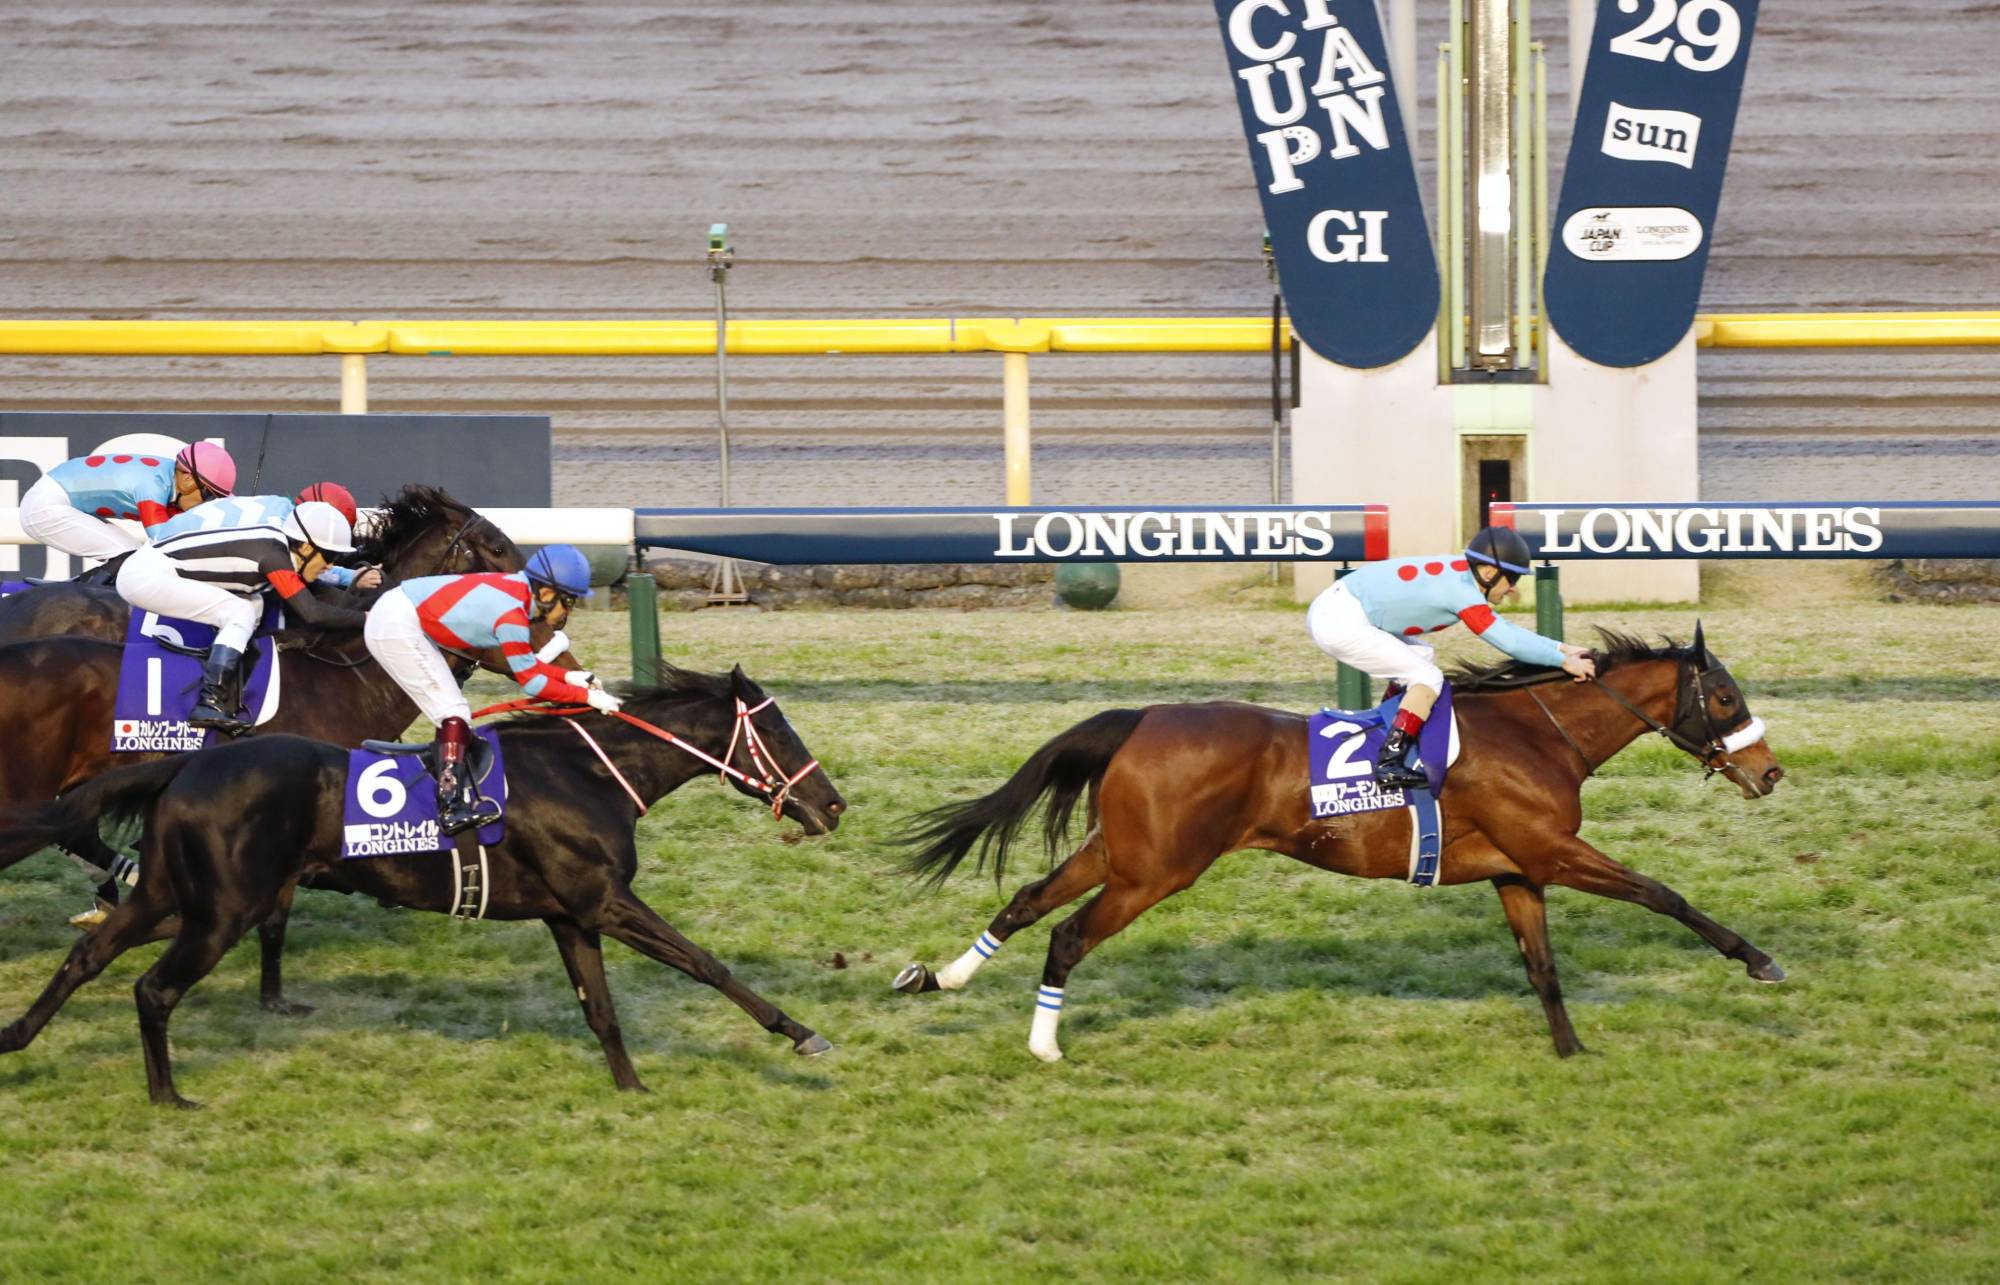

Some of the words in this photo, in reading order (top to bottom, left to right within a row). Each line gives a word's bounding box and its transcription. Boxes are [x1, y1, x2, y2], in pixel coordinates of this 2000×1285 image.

[1609, 0, 1741, 72] 29
[1612, 117, 1688, 153] sun
[1307, 209, 1388, 263] GI
[993, 511, 1334, 557] LONGINES
[1539, 507, 1883, 553] LONGINES
[147, 657, 162, 716] 1
[115, 736, 204, 751] LONGINES
[1319, 720, 1373, 780] 2
[357, 758, 407, 818] 6
[1314, 793, 1405, 816] LONGINES
[347, 837, 440, 857] LONGINES
[370, 820, 440, 841] コントレイル
